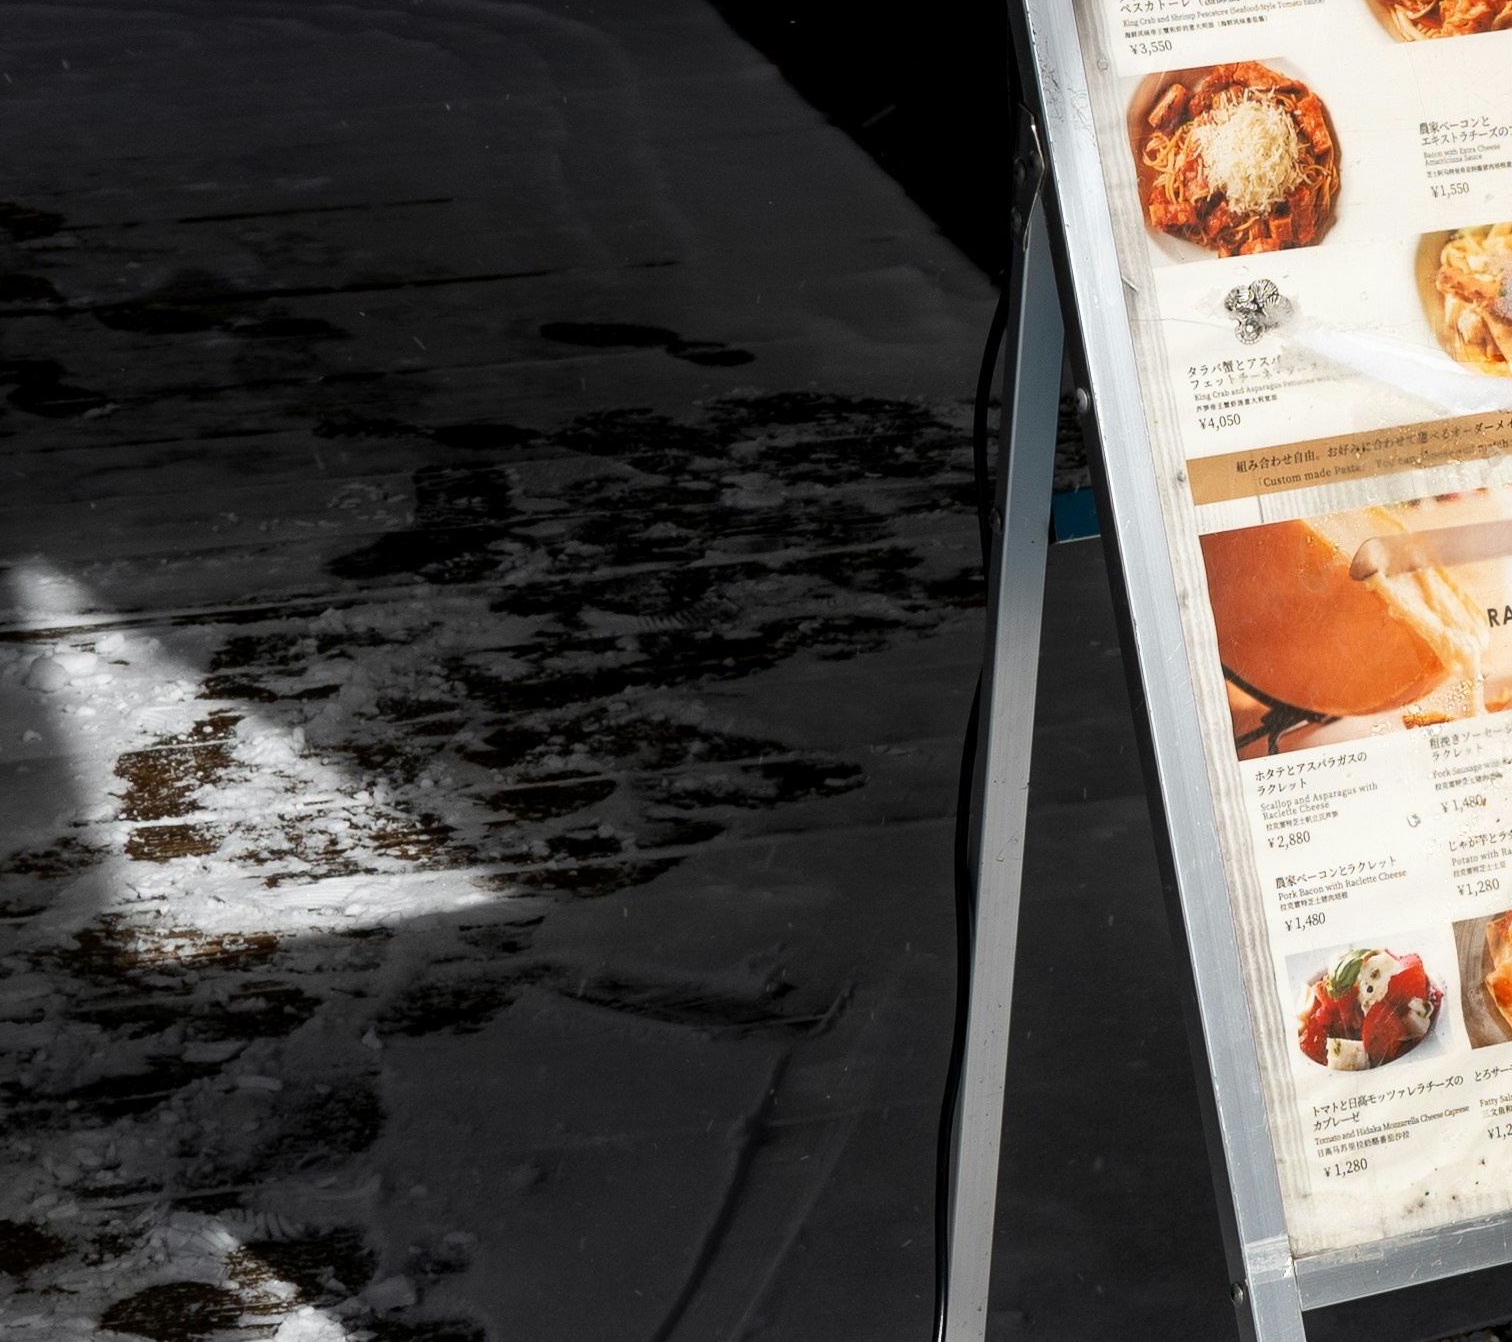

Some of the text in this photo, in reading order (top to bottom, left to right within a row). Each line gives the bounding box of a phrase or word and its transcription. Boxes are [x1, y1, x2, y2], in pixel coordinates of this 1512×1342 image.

[1139, 16, 1156, 25] Crab
[1157, 15, 1170, 23] and
[1130, 39, 1172, 56] ¥3,550
[1419, 116, 1490, 135] 農家ベーコンと
[1431, 182, 1469, 199] ¥1,550
[1194, 393, 1211, 401] King
[1213, 390, 1229, 399] Crab
[1199, 413, 1241, 431] ¥4,050
[1236, 450, 1321, 473] 組み合わせ自由。
[1304, 468, 1331, 480] made
[1255, 751, 1368, 782] ホタテとアスパラガスの
[1257, 778, 1307, 796] ラクレット
[1261, 781, 1378, 812] Scallop and Asparagus with
[1263, 801, 1330, 821] Raclette Cheese
[1268, 830, 1310, 850] ¥2,880
[1451, 854, 1478, 866] Potato
[1481, 850, 1499, 860] with
[1276, 855, 1396, 889] 農家ベーコンとラクレット
[1278, 869, 1407, 901] Pork Bacon with Raclette Cheese
[1457, 878, 1500, 897] ¥1,280
[1285, 912, 1326, 932] ¥1,480
[1313, 1075, 1464, 1117] トマトと日高モッツァレラチーズの
[1480, 1097, 1498, 1107] Fatty
[1315, 1135, 1341, 1146] Tomato
[1342, 1131, 1355, 1140] and
[1324, 1158, 1368, 1178] ¥1,280
